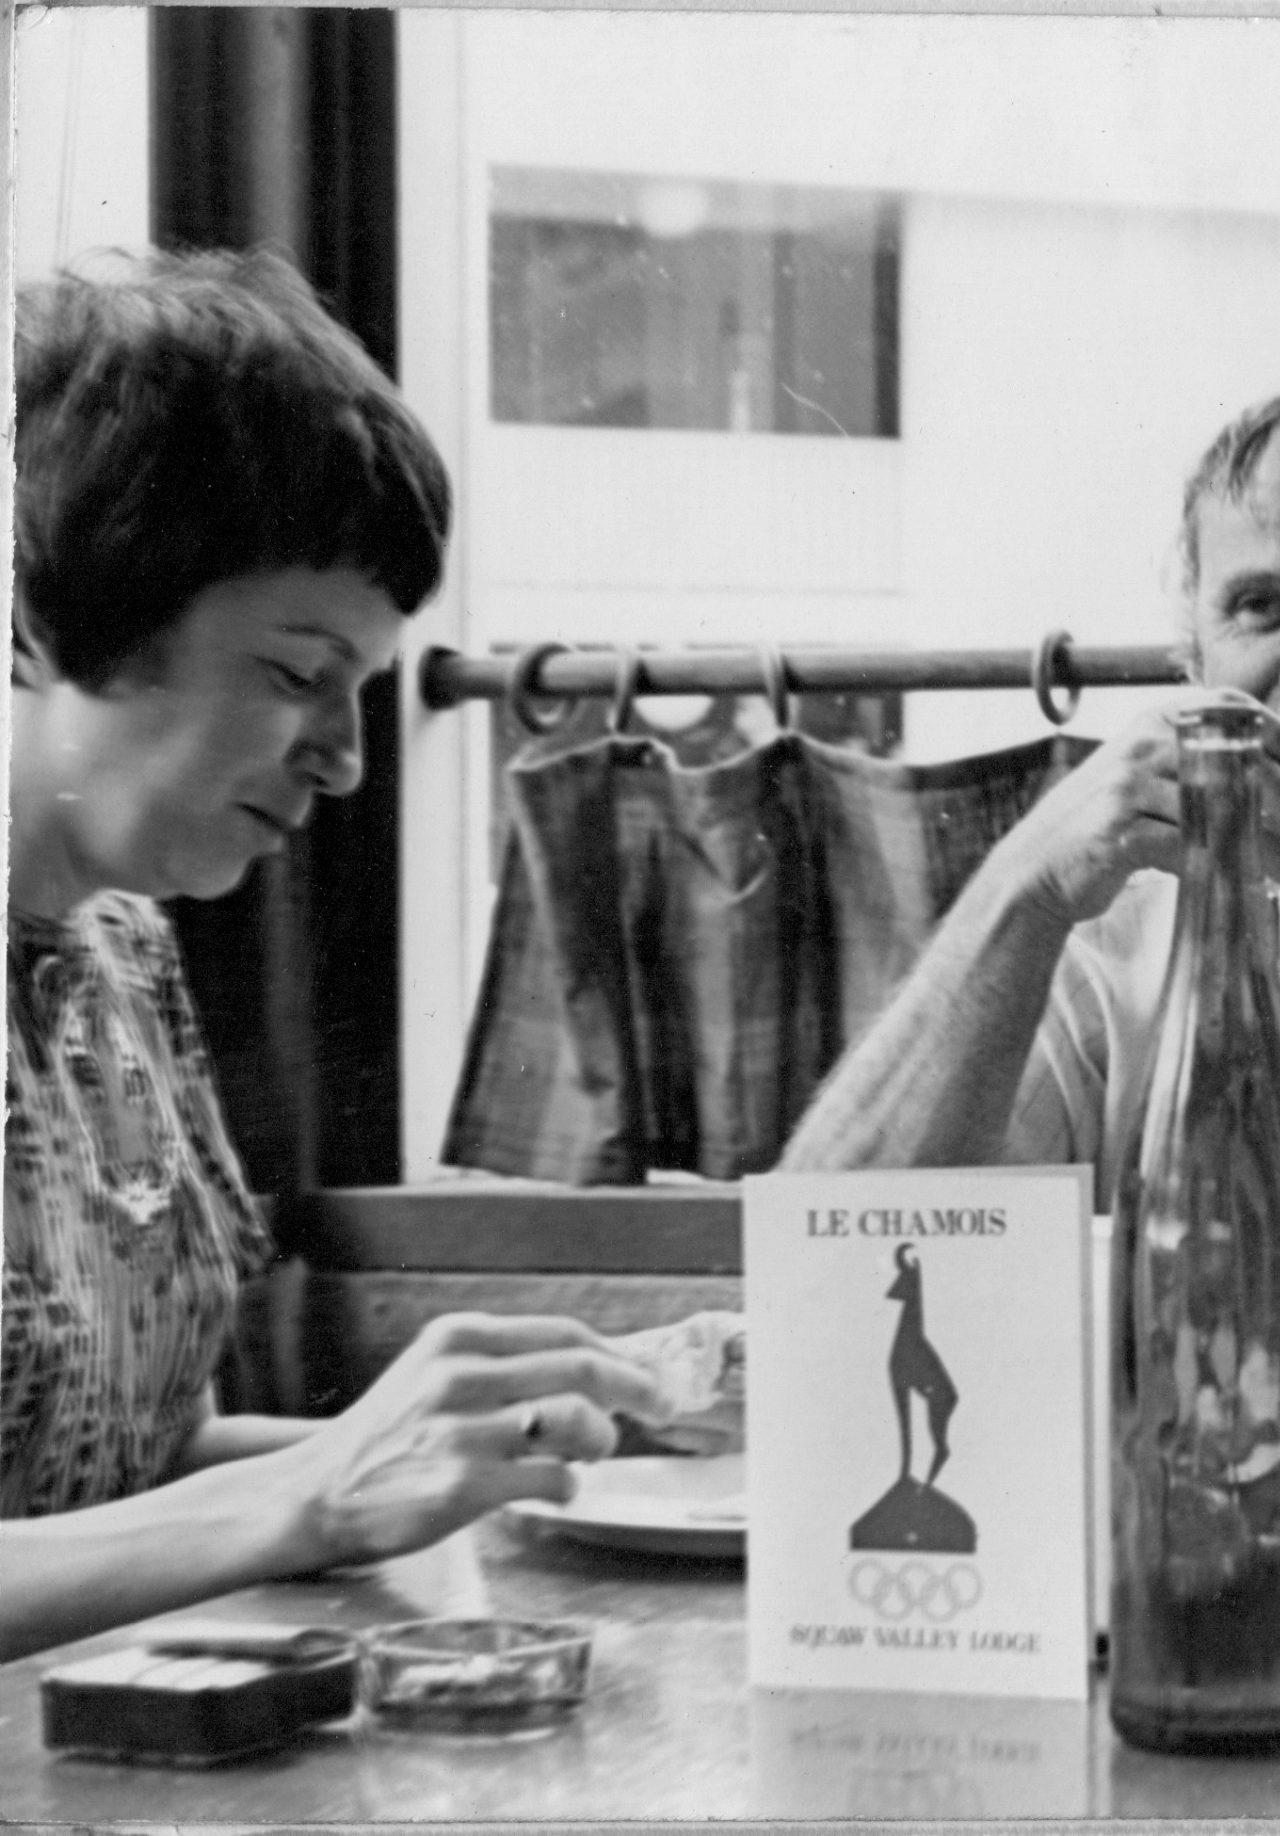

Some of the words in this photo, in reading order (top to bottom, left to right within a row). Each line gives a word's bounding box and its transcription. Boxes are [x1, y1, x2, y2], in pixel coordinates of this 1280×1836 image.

[807, 1208, 849, 1236] LE
[858, 1207, 1007, 1236] CHAMOIS
[790, 1624, 865, 1650] SQUAW
[873, 1627, 959, 1648] VALLEY
[969, 1630, 1040, 1652] LODGE
